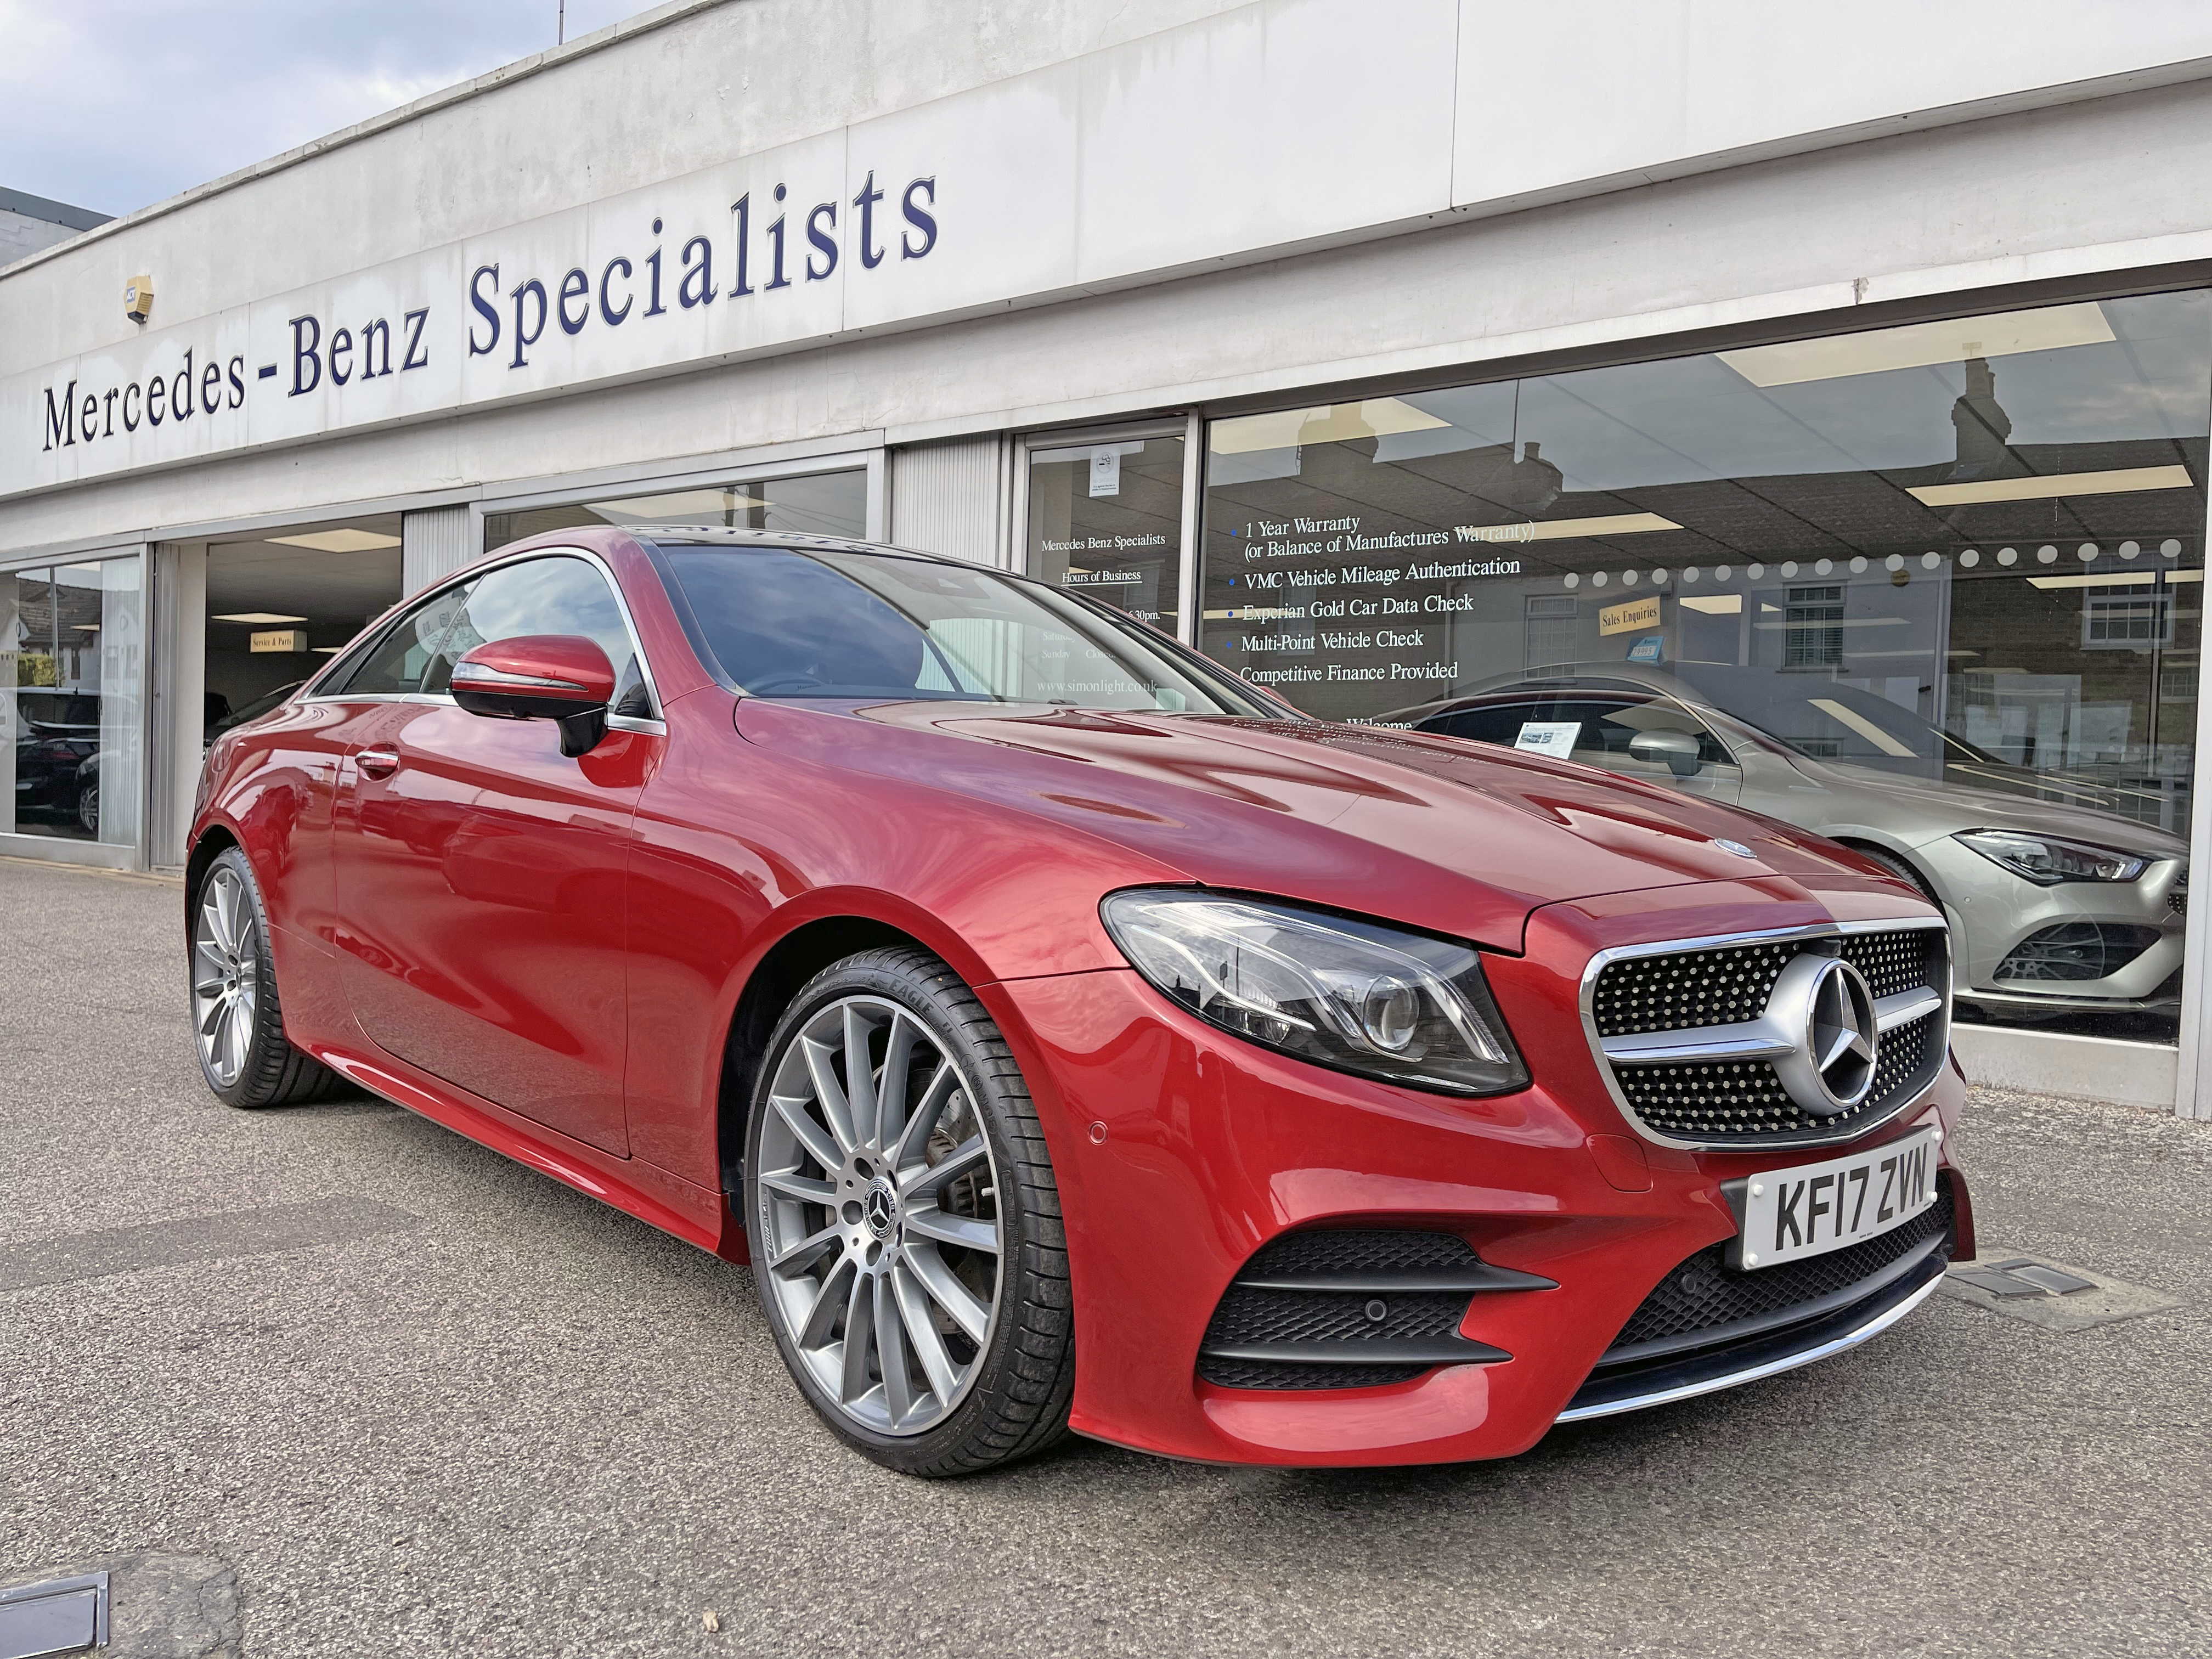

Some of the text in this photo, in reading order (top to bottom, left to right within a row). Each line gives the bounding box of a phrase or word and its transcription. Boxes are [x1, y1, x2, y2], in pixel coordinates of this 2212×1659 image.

[42, 170, 939, 453] Mercedes-Benz Specialists
[1246, 515, 1361, 538] 1 Year Warranty
[1041, 533, 1166, 551] Mercedes Benz Specialists
[1245, 519, 1535, 563] (or Balance of Manufactures Warranty)
[1062, 569, 1141, 583] Hours of Business
[1244, 556, 1521, 590] VMC Vehicle Mileage Authentication
[1242, 593, 1474, 624] Experian Gold Car Data Check
[1602, 605, 1657, 627] Sales Enquiries
[278, 636, 292, 646] Parts
[1241, 629, 1424, 651] Multi-Point Vehicle Check
[1042, 649, 1070, 660] Sunday
[1240, 661, 1458, 686] Competitive Finance Provided
[1037, 679, 1158, 695] www.simonlight.co.uk
[889, 978, 934, 1019] EAGLE
[1775, 1142, 1928, 1251] KF17 ZVN
